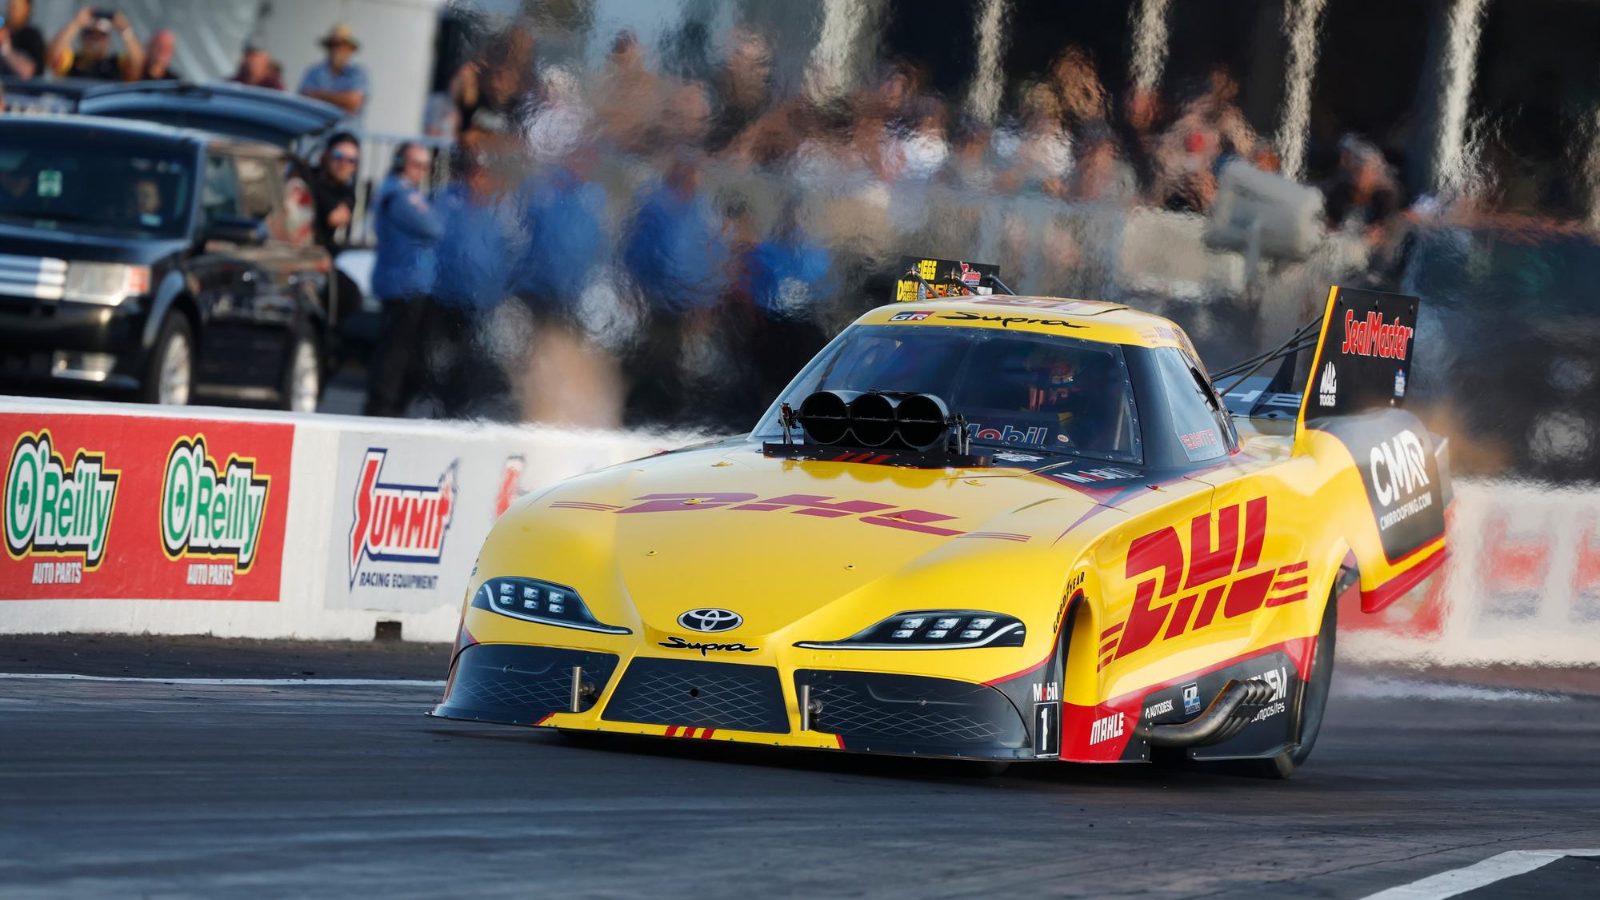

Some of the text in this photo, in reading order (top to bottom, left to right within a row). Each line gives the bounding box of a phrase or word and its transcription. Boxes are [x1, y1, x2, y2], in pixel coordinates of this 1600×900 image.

[937, 311, 1091, 328] Supra
[1342, 309, 1413, 360] SealMaster
[1320, 361, 1337, 394] MAC
[1319, 394, 1336, 407] TOOLS
[1369, 429, 1430, 507] CMR
[6, 438, 115, 562] O'Reilly
[163, 443, 267, 565] O'Reilly
[1380, 491, 1432, 531] CMRROOFING.COM
[613, 492, 968, 537] DHL
[32, 562, 82, 584] AUTO PARTS
[186, 564, 234, 586] AUTO PARTS
[359, 572, 439, 588] RACING EQUIPMENT
[1113, 495, 1278, 661] DHL
[658, 636, 760, 656] Supra
[1033, 682, 1059, 702] Mobil
[1150, 700, 1174, 718] AUTODESK
[1250, 701, 1286, 723] omposites
[1089, 711, 1125, 746] MAHLE
